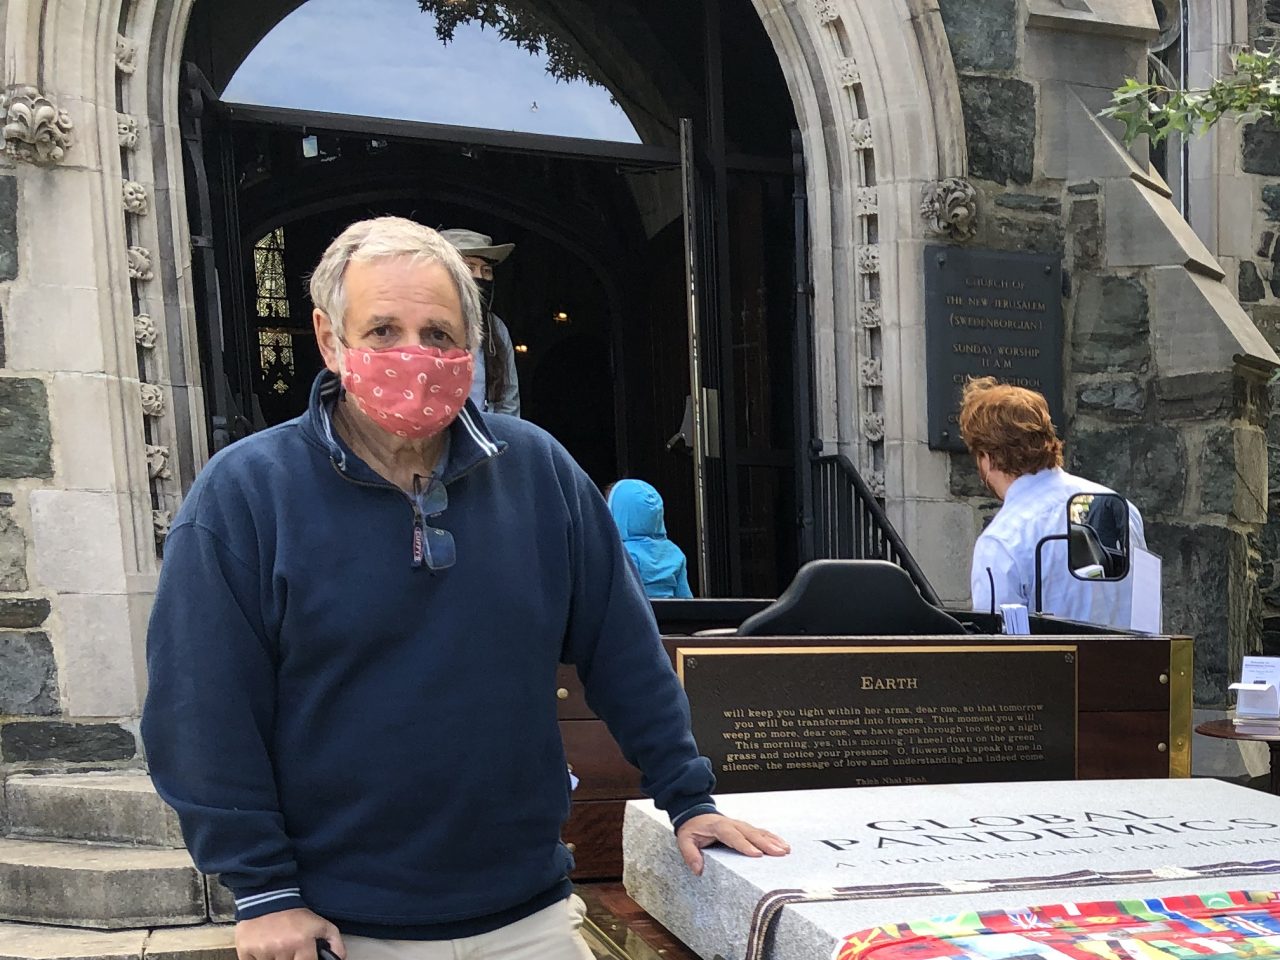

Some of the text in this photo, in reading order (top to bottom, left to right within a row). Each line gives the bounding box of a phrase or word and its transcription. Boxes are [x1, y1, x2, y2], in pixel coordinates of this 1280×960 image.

[946, 296, 1046, 311] THE NEW JERUSALEM
[953, 343, 1040, 357] SUNDAY WORSHIP
[861, 676, 918, 690] EARTH
[723, 708, 744, 718] will
[748, 708, 774, 719] keep
[776, 709, 796, 718] you
[799, 707, 825, 718] tight
[827, 707, 861, 716] within
[864, 707, 882, 715] her
[916, 705, 938, 714] dear
[978, 704, 997, 712] that
[1000, 704, 1044, 712] tomorrow
[734, 720, 754, 730] you
[757, 718, 778, 728] will
[781, 718, 794, 728] be
[798, 717, 860, 727] transformed
[864, 717, 884, 725] into
[932, 715, 954, 724] This
[957, 715, 994, 723] moment
[996, 715, 1014, 724] you
[1017, 713, 1035, 721] will
[722, 732, 751, 740] weep
[754, 731, 767, 739] no
[803, 728, 826, 737] dear
[870, 726, 895, 735] have
[897, 727, 921, 736] gone
[923, 725, 962, 735] through
[965, 725, 981, 733] too
[983, 725, 1007, 734] deep
[735, 741, 760, 750] This
[837, 737, 858, 746] this
[917, 736, 944, 744] kneel
[991, 734, 1006, 742] the
[1008, 735, 1035, 743] green
[726, 753, 757, 763] grass
[760, 751, 779, 760] and
[783, 750, 815, 759] notice
[817, 750, 841, 759] your
[911, 747, 948, 755] flowers
[973, 745, 1001, 754] speak
[1003, 744, 1013, 752] to
[1032, 743, 1042, 751] in
[766, 754, 1017, 770] the message of love and understanding has indeed
[866, 809, 1174, 831] GLOBAL
[813, 818, 1278, 850] PANDEMICS
